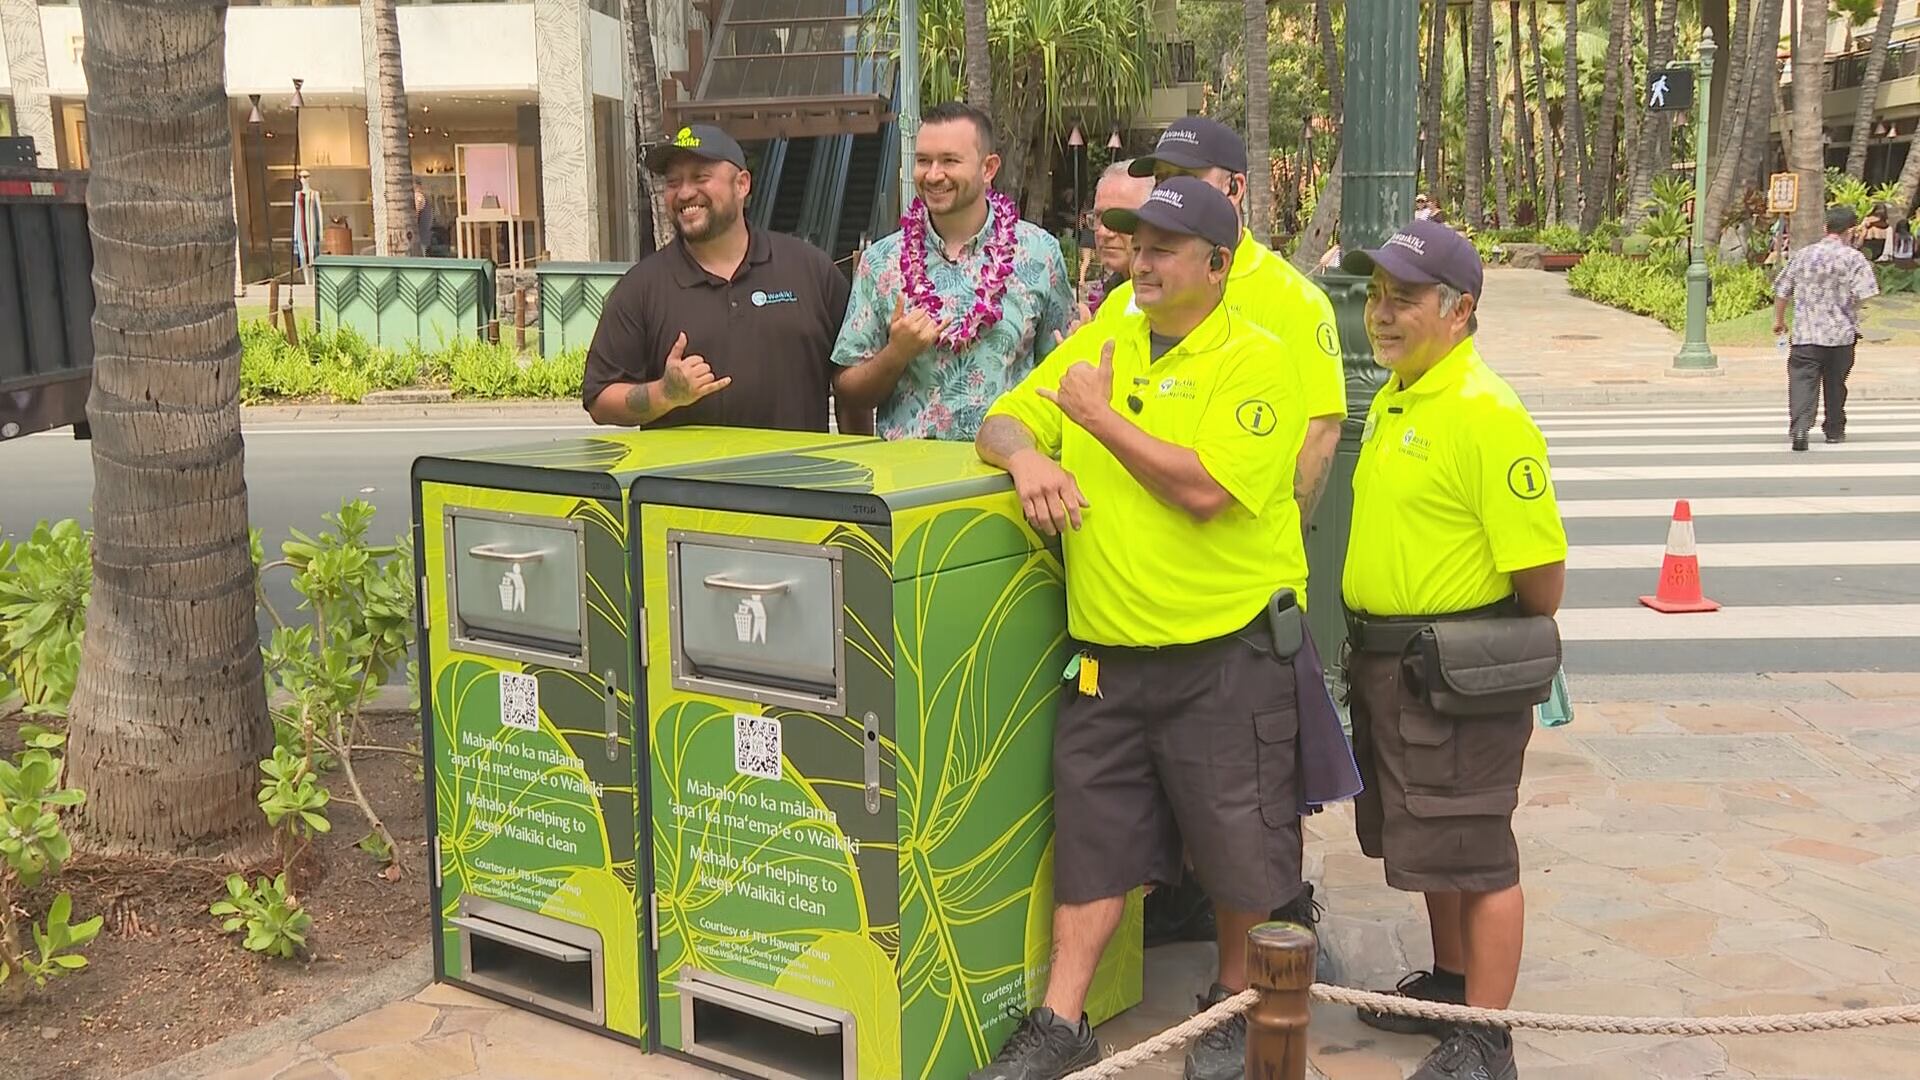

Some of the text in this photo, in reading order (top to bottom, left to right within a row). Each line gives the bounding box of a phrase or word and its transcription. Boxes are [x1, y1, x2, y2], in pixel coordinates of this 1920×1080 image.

[462, 731, 584, 770] Mahalo no ka mālama
[478, 756, 490, 772] ka
[550, 776, 558, 787] o
[560, 775, 604, 799] Waikīkī
[466, 791, 586, 834] Mahalo for helping to
[687, 778, 837, 824] Mahalo no ka mālama
[475, 815, 502, 838] keep
[546, 834, 577, 854] clean
[698, 805, 701, 819] i
[705, 806, 720, 824] ka
[794, 829, 804, 843] o
[807, 829, 860, 856] Waikīkī
[474, 857, 507, 876] Courtesy
[507, 867, 516, 875] of
[556, 879, 582, 897] Group
[690, 845, 838, 893] Mahalo for helping to
[701, 871, 733, 897] keep
[788, 894, 826, 916] clean
[699, 917, 738, 938] Courtesy
[740, 928, 750, 938] of
[752, 931, 768, 944] JTB
[801, 943, 830, 961] Group
[750, 948, 773, 961] County
[773, 953, 781, 961] of
[982, 982, 1013, 1005] Courtesy
[1014, 974, 1023, 989] of
